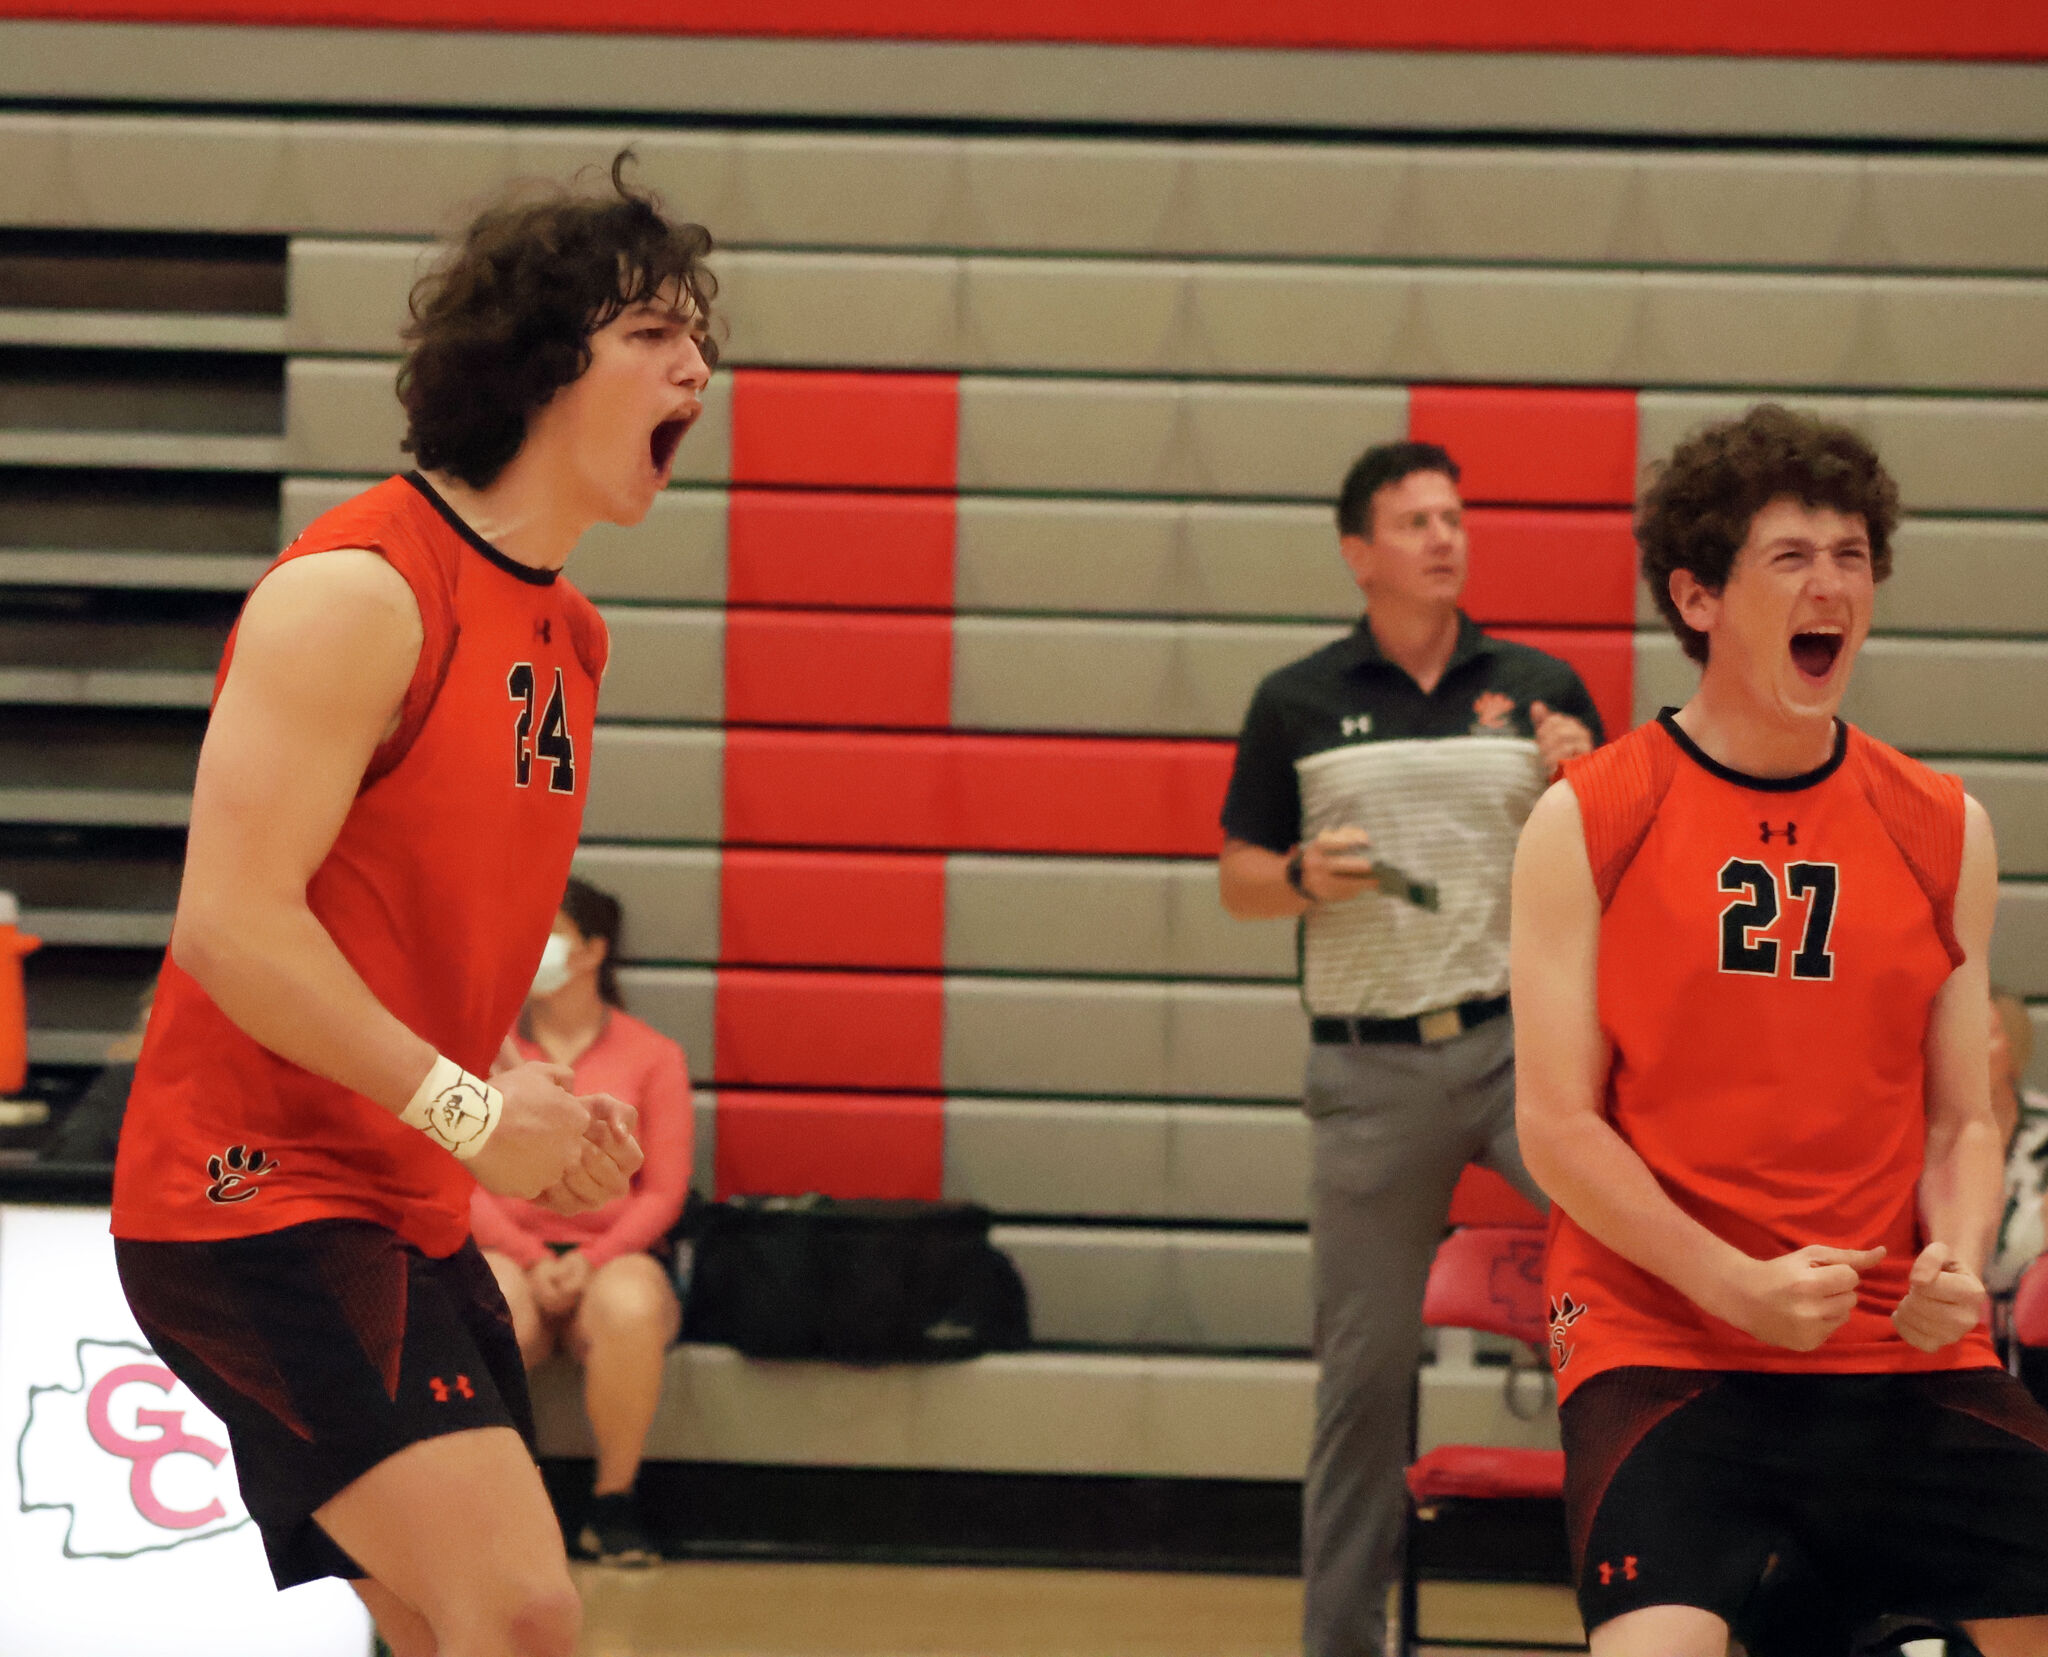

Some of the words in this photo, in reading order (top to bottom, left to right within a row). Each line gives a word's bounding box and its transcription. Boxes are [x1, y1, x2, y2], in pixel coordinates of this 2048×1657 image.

[507, 661, 575, 795] 24
[1717, 856, 1840, 981] 27
[87, 1363, 229, 1529] GC
